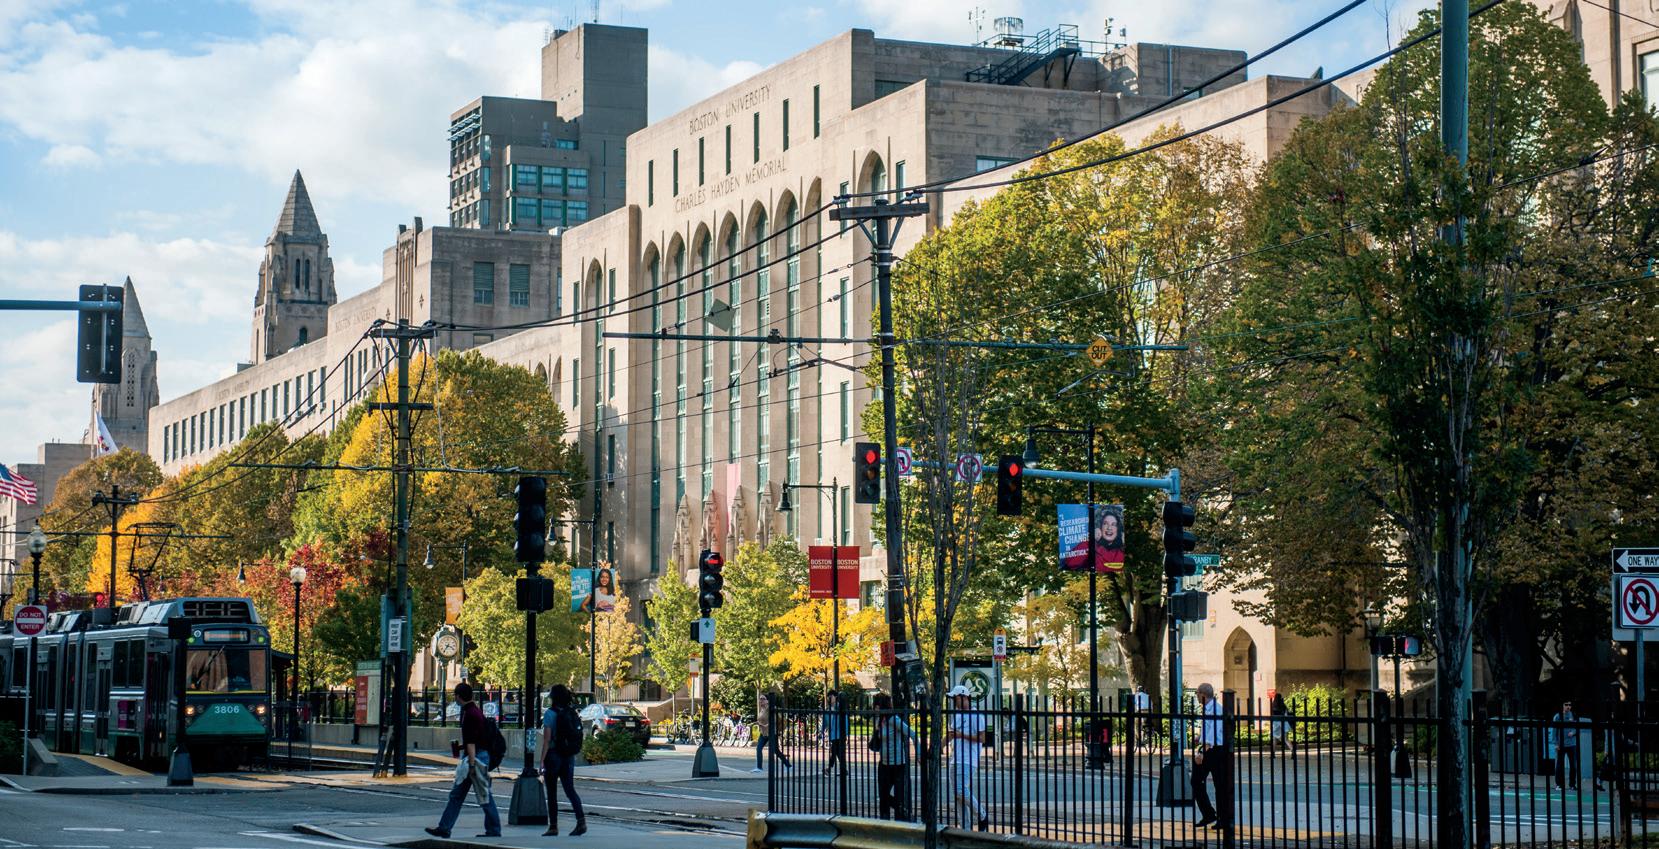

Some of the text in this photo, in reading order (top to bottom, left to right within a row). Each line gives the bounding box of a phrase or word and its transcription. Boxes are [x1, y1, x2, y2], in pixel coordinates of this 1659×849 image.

[690, 84, 772, 135] BOSTON UNIVERSITY
[675, 156, 787, 213] CHARLES HAYDEN MEMORIAL
[1092, 345, 1107, 353] CUT
[1091, 352, 1107, 360] OUT
[1058, 524, 1087, 537] CLIMATE
[1628, 556, 1658, 566] ONE WAY
[214, 705, 240, 714] 3806
